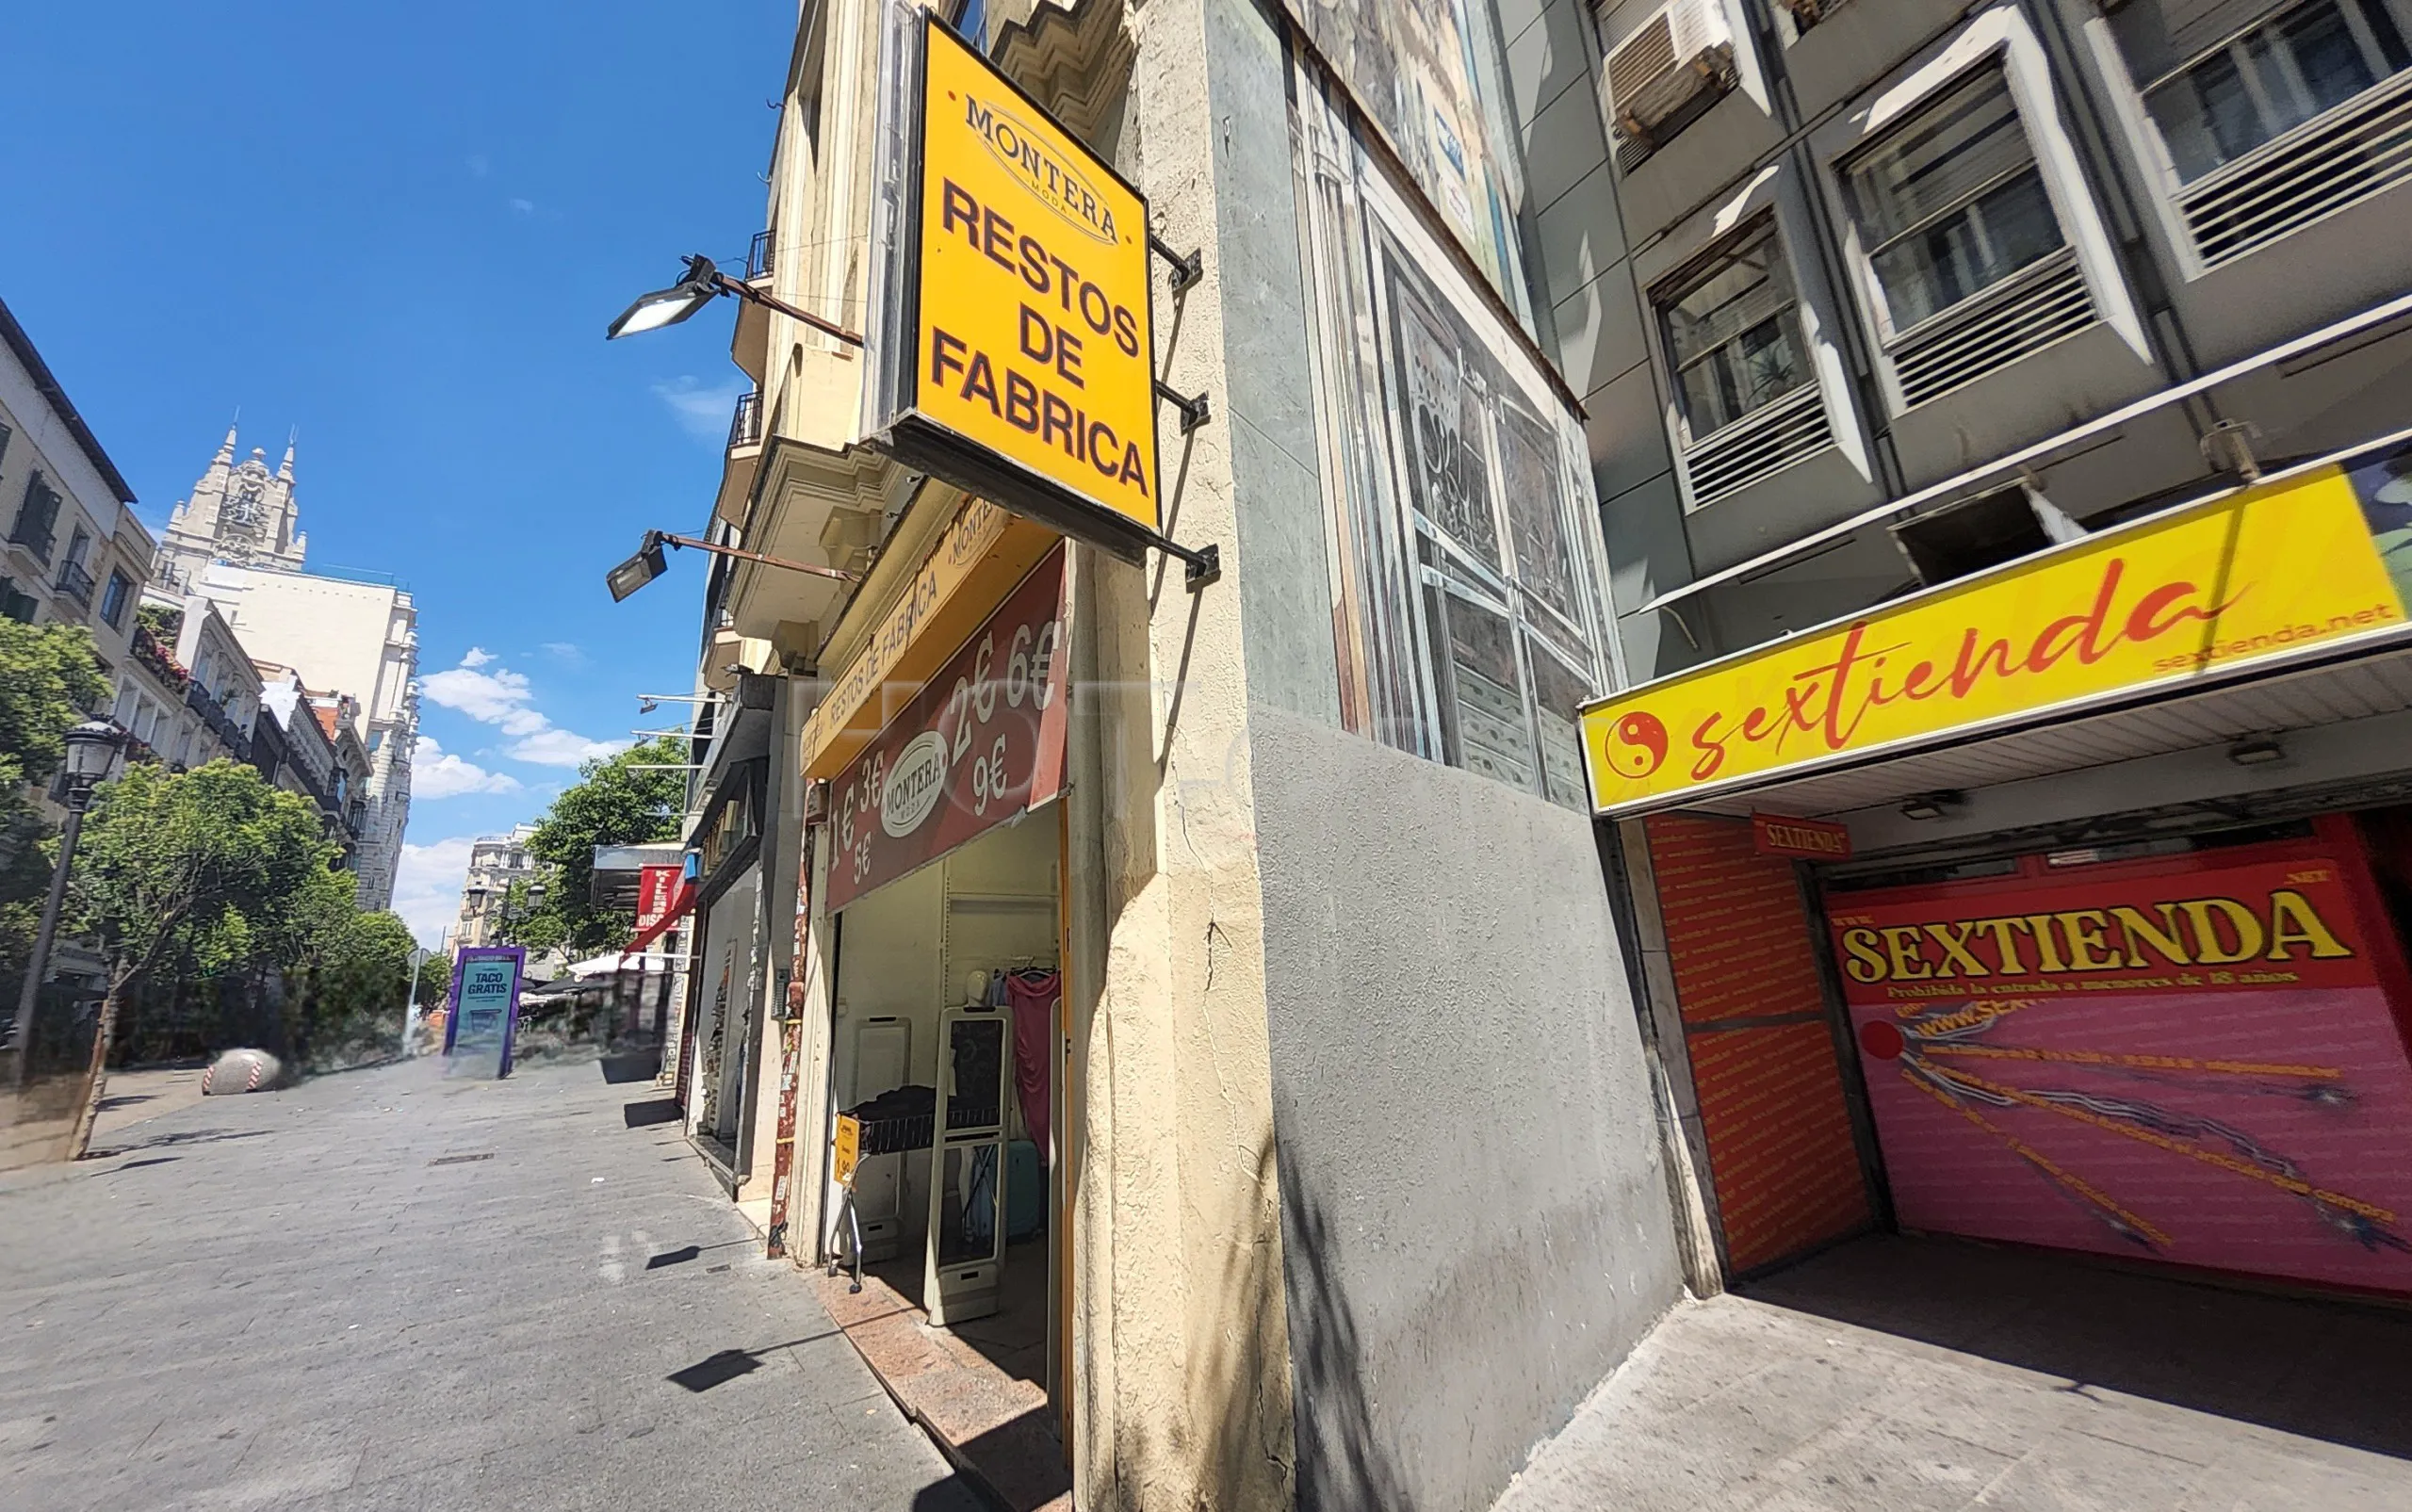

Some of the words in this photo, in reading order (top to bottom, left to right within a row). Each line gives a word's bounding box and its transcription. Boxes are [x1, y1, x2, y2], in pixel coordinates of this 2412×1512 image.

[966, 93, 1118, 245] MONTERA
[942, 177, 1139, 358] RESTOS
[1019, 301, 1084, 390] DE
[931, 326, 1149, 498] FABRICA
[830, 666, 864, 725] RESTOS
[866, 644, 880, 687] DE
[882, 570, 937, 666] FABRICA
[1690, 558, 2258, 781] sextienda
[2152, 603, 2397, 674] sextienda.net
[886, 753, 941, 818] MONTERA
[475, 972, 503, 983] TACO
[1842, 888, 2355, 984] SEXTIENDA
[468, 984, 507, 995] GRATIS
